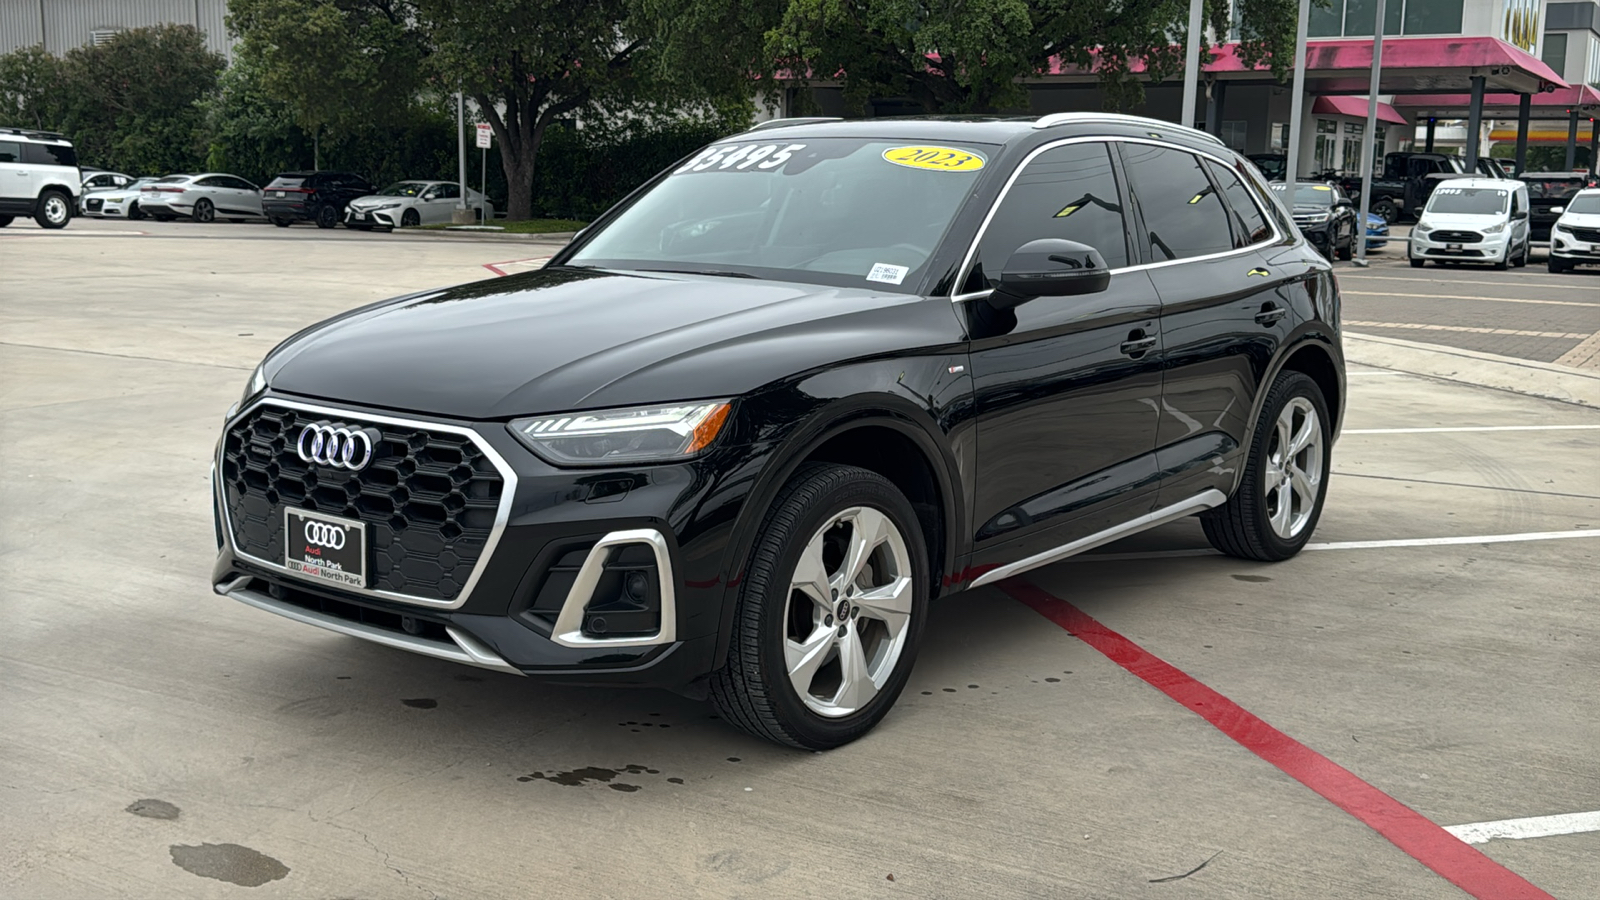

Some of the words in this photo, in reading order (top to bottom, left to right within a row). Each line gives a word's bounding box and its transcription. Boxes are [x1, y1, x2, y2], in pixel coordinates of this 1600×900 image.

[895, 149, 973, 167] 2023
[305, 545, 321, 556] Audi
[304, 554, 326, 567] North
[326, 560, 343, 571] Park
[302, 564, 320, 576] Audi
[320, 568, 344, 582] North
[344, 574, 362, 586] Park
